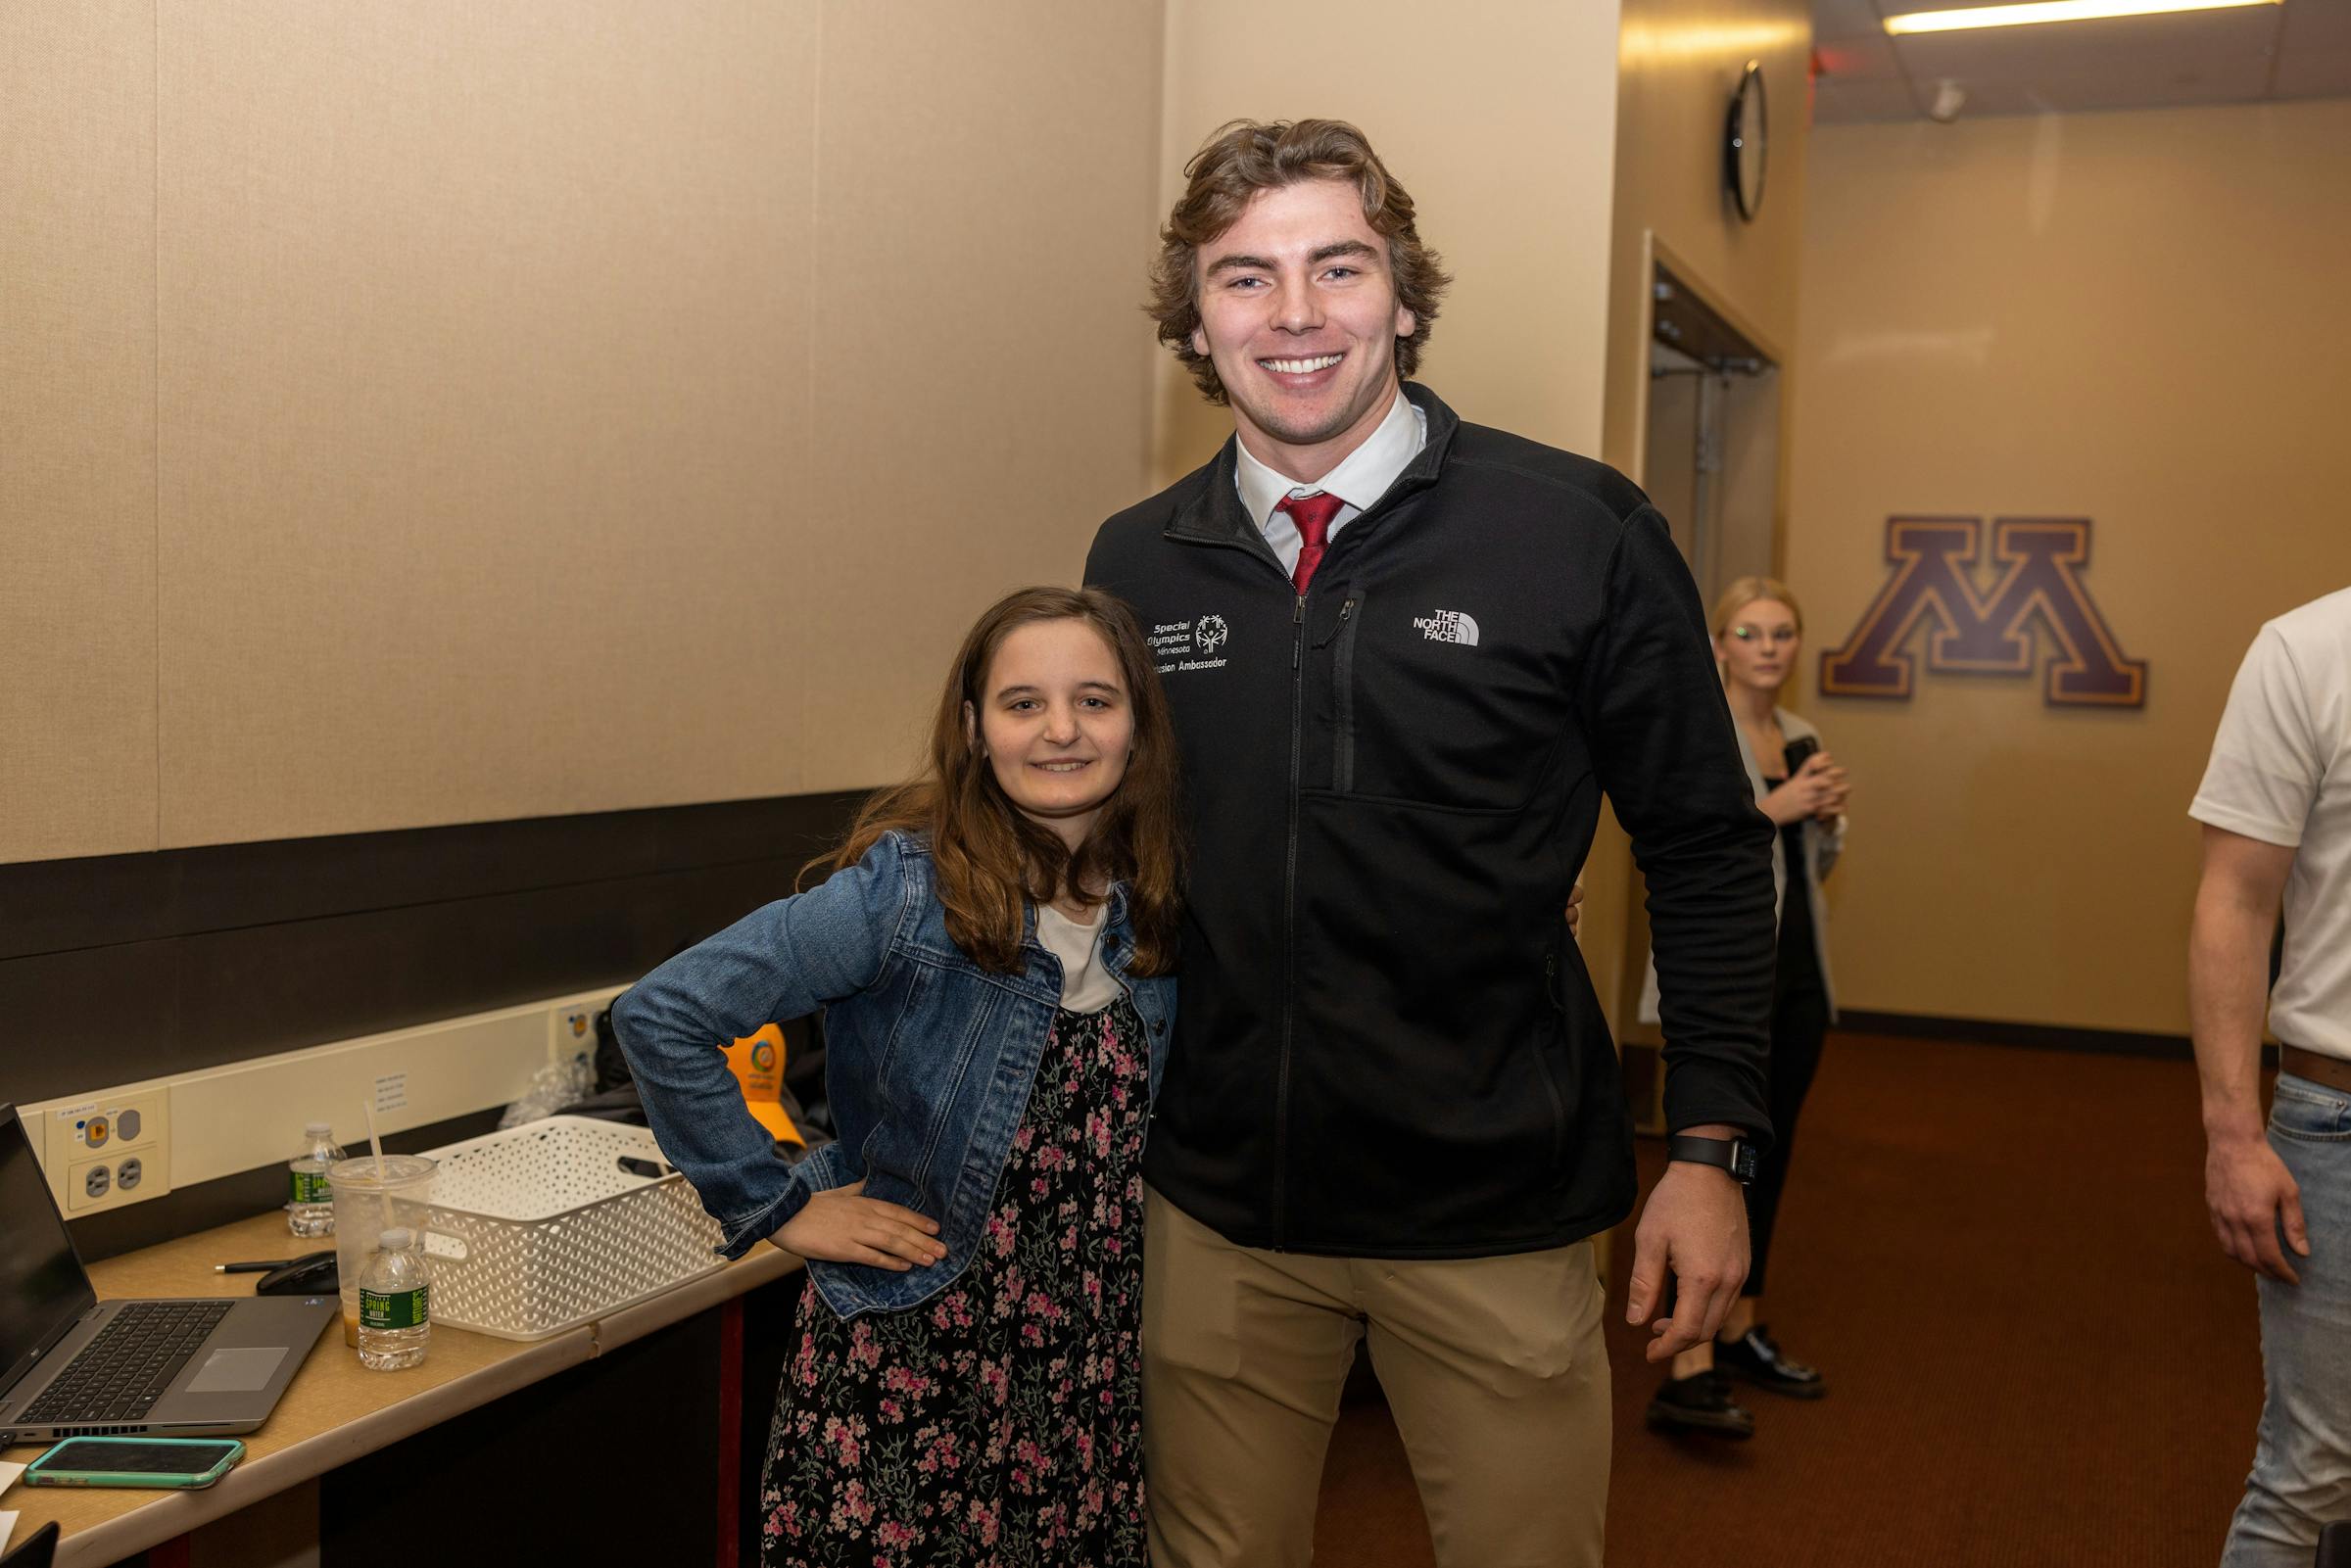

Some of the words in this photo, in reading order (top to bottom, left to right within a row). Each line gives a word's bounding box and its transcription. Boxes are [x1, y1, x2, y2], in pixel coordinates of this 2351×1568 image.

[1435, 609, 1459, 622] THE
[1821, 517, 2147, 707] M
[1154, 620, 1190, 634] Special
[1414, 617, 1457, 633] NORTH
[1147, 633, 1190, 646] Olympics
[1424, 629, 1456, 642] FACE
[1178, 656, 1227, 671] Ambassador
[365, 1298, 390, 1311] SPRING
